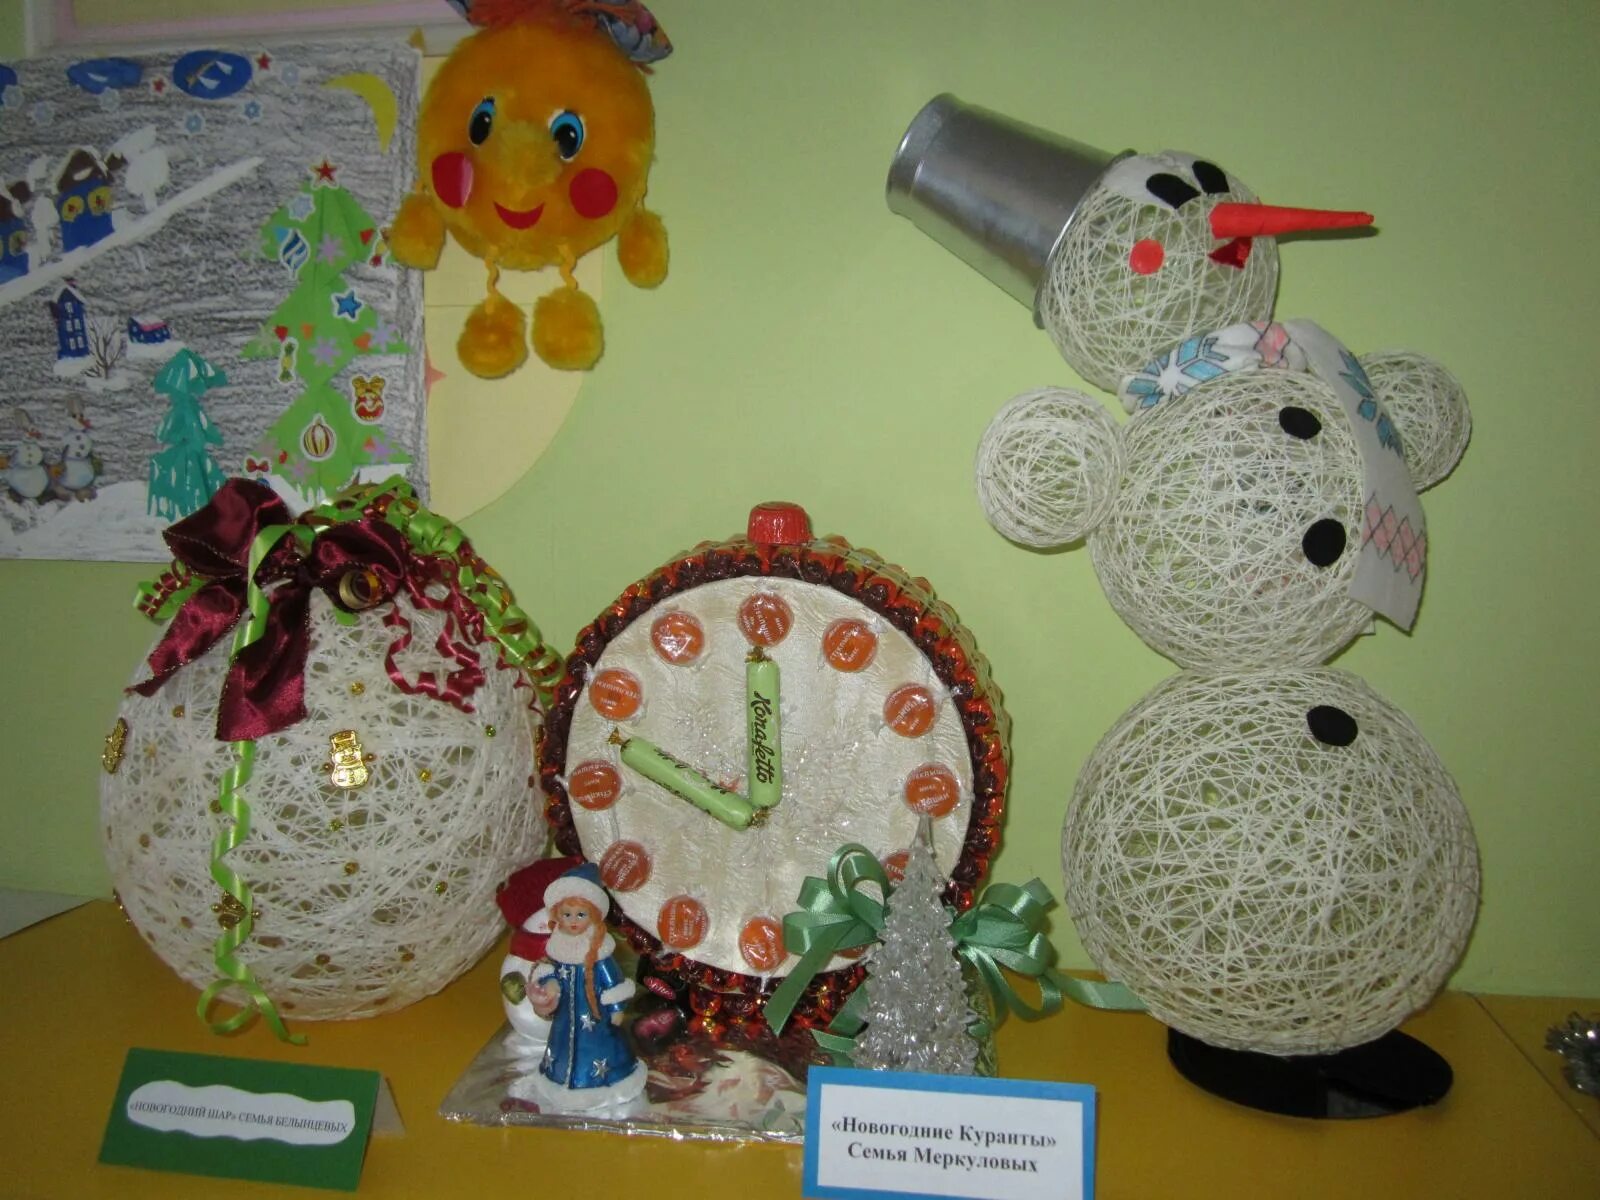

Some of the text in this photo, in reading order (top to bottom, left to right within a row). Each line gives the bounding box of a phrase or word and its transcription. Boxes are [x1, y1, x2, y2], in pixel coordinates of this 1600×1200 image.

[129, 1101, 206, 1118] «НОВОГОДНИЙ
[207, 1108, 236, 1120] ШАР»
[238, 1111, 273, 1126] СЕМЬЯ
[831, 1116, 1057, 1148] «Новогодние Куранты»
[847, 1142, 1039, 1173] Семья Меркуловых
